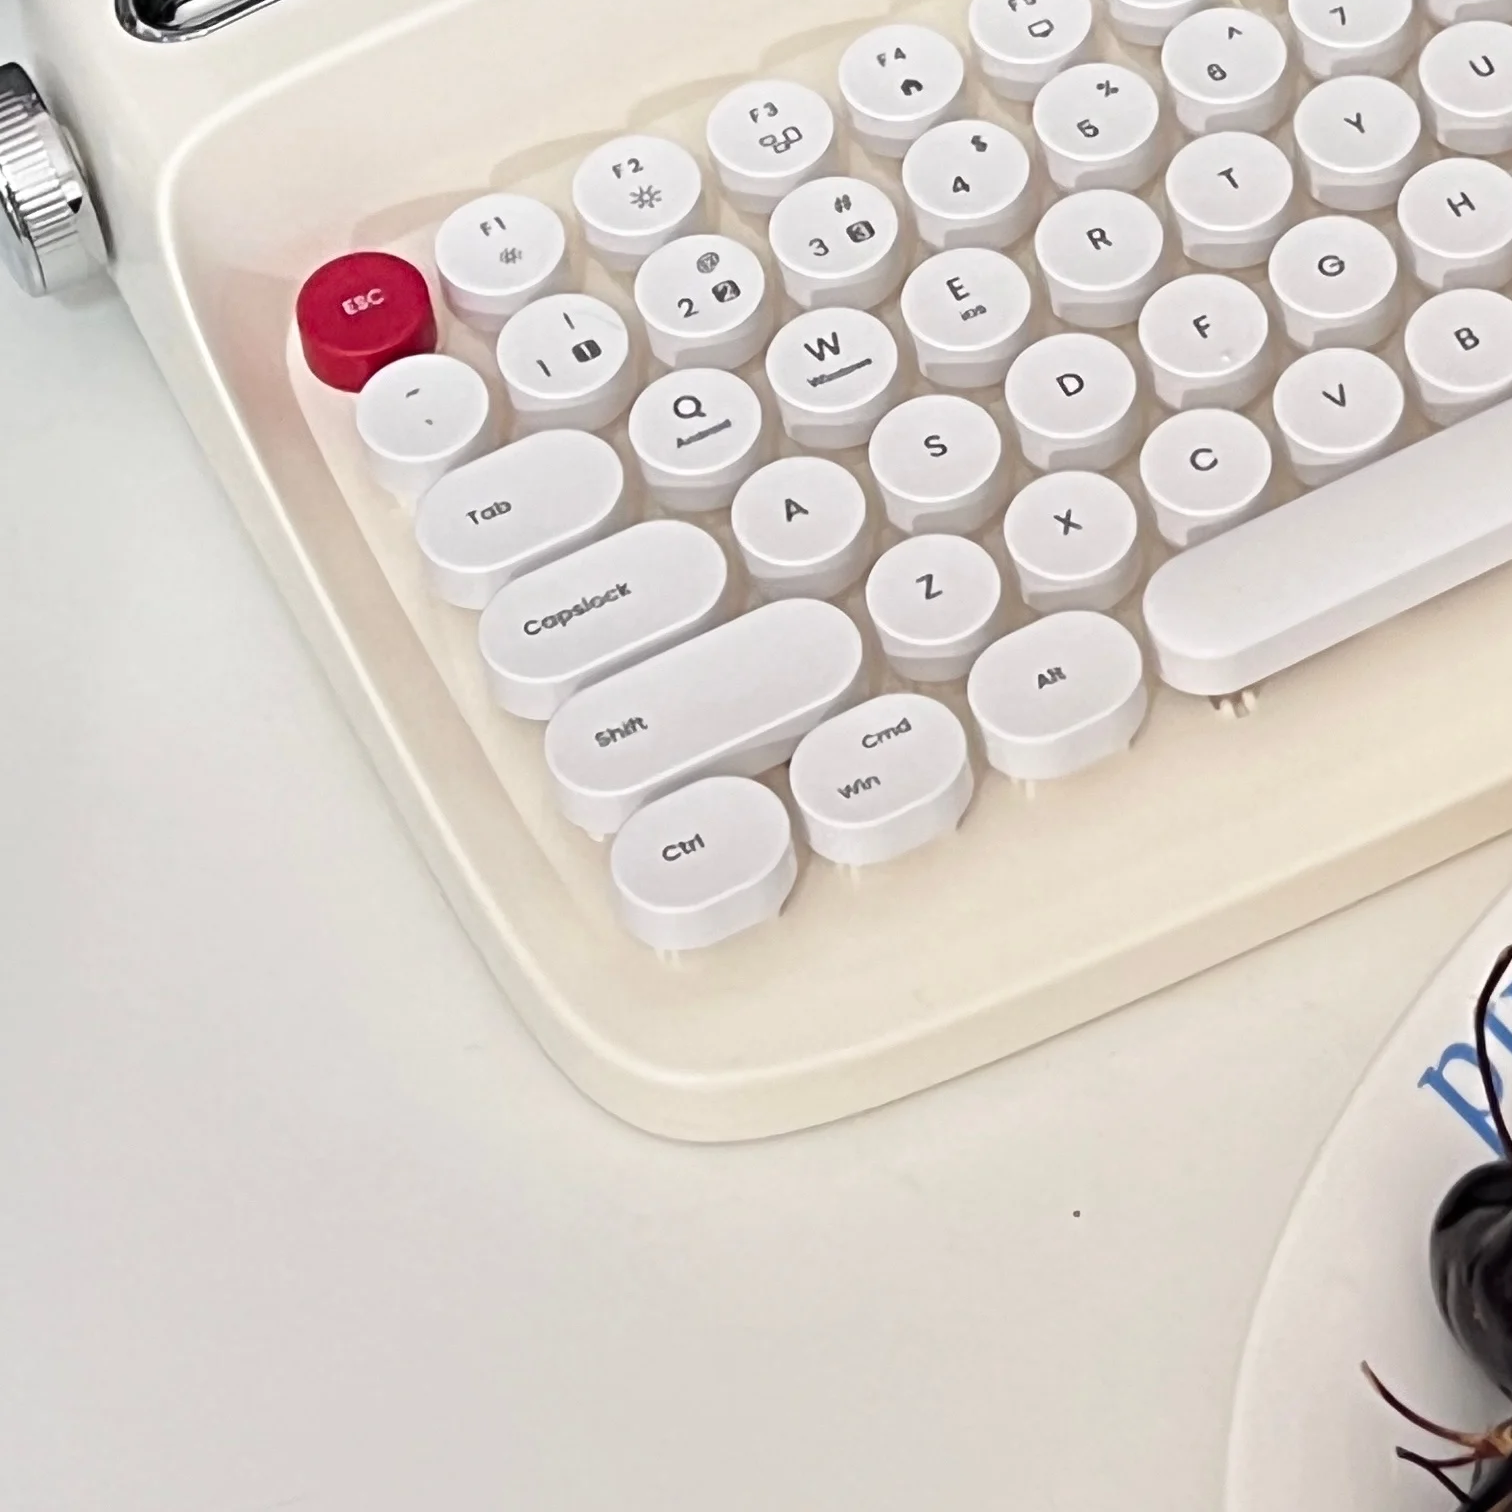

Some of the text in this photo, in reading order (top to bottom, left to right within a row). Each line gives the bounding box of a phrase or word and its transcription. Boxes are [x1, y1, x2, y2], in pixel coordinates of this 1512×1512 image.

[1329, 6, 1346, 25] 7
[1468, 55, 1496, 78] U
[1343, 112, 1366, 134] Y
[612, 157, 644, 179] F2
[1217, 167, 1239, 189] T
[1446, 191, 1476, 217] H
[808, 238, 829, 256] 3
[1086, 227, 1113, 251] R
[1317, 254, 1346, 277] G
[946, 276, 970, 302] E
[676, 298, 700, 318] 2
[1192, 314, 1211, 339] F
[1453, 327, 1480, 351] B
[803, 331, 841, 362] W
[1055, 373, 1085, 397] D
[1322, 383, 1347, 408] V
[672, 394, 708, 420] Q
[923, 434, 948, 458] S
[465, 500, 513, 525] Tab
[784, 497, 809, 522] A
[1053, 508, 1083, 536] X
[915, 573, 944, 601] Z
[593, 716, 648, 749] Shift
[861, 717, 913, 750] Cmd
[661, 834, 706, 863] Ctrl
